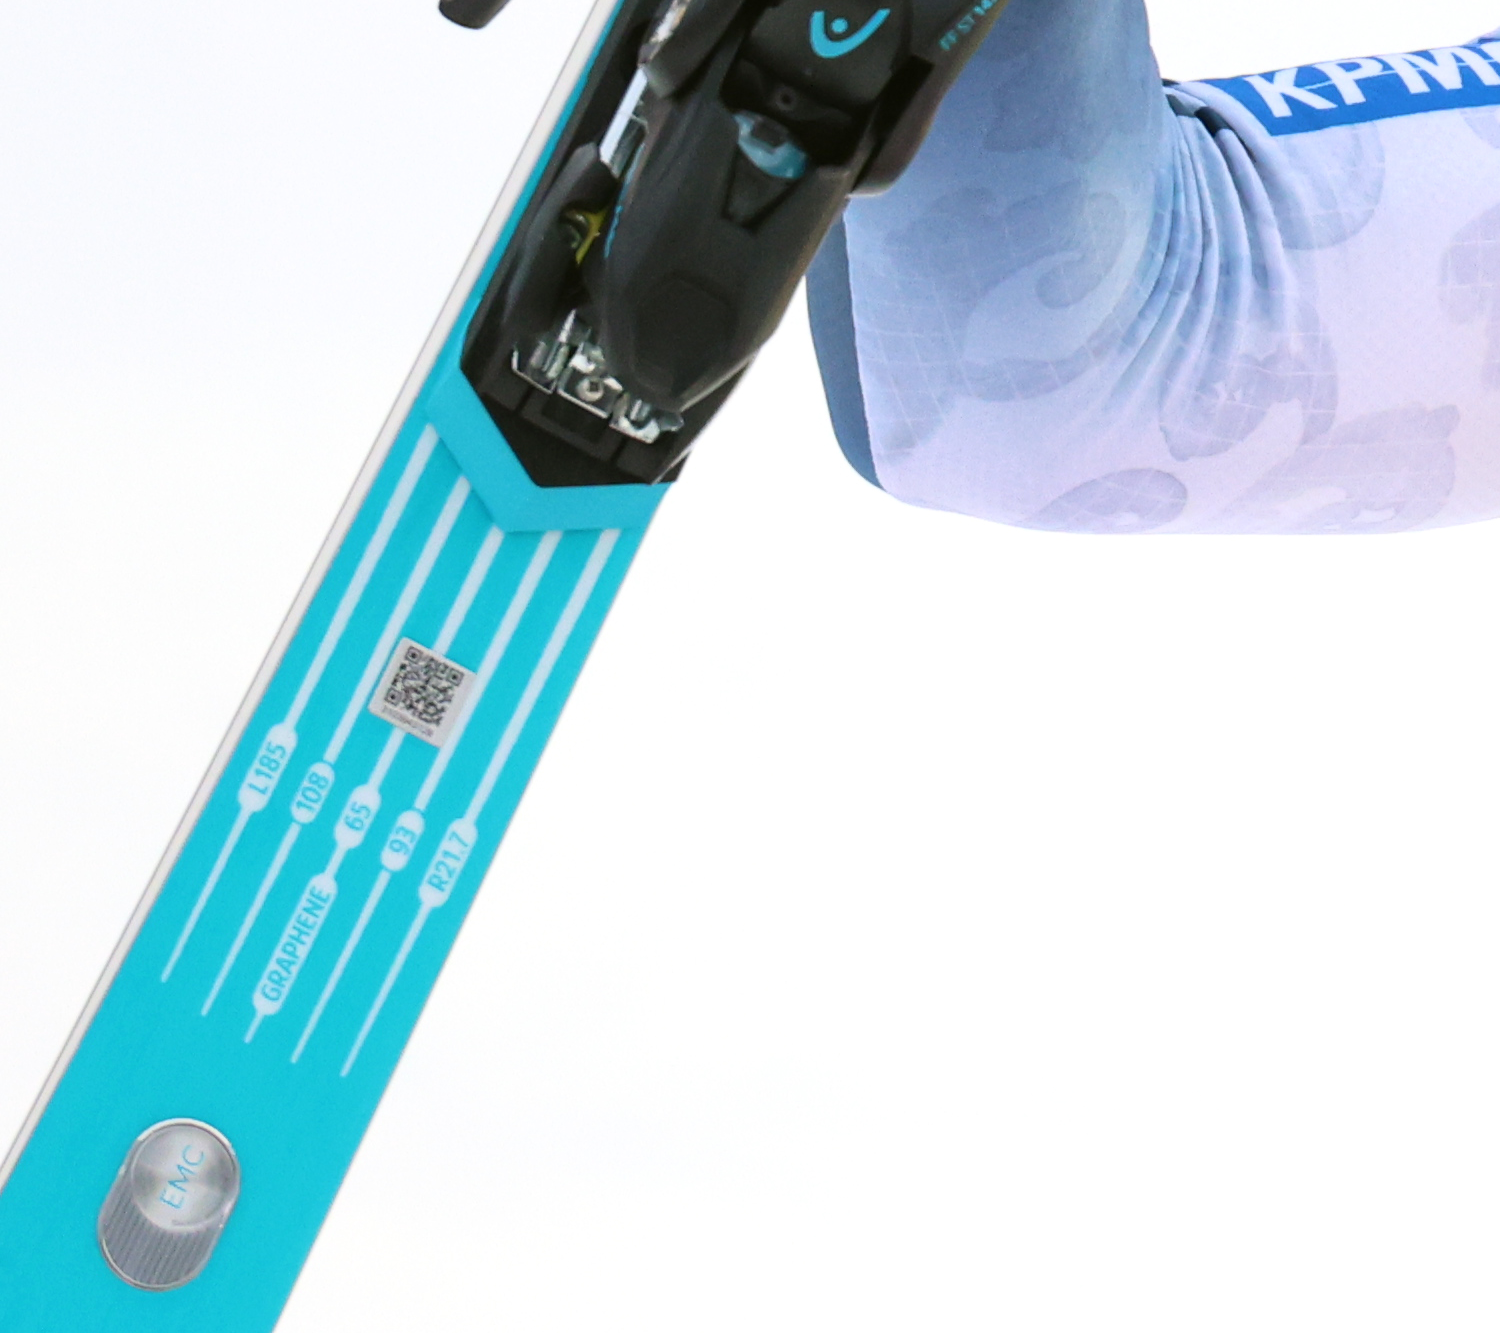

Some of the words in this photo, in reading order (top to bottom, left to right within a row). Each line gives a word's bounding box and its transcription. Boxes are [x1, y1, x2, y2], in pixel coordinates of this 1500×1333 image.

[296, 772, 329, 811] 108
[344, 801, 371, 831] 65
[389, 825, 416, 855] 93
[261, 885, 331, 1002] GRAPHENE
[160, 1144, 206, 1209] EMC
